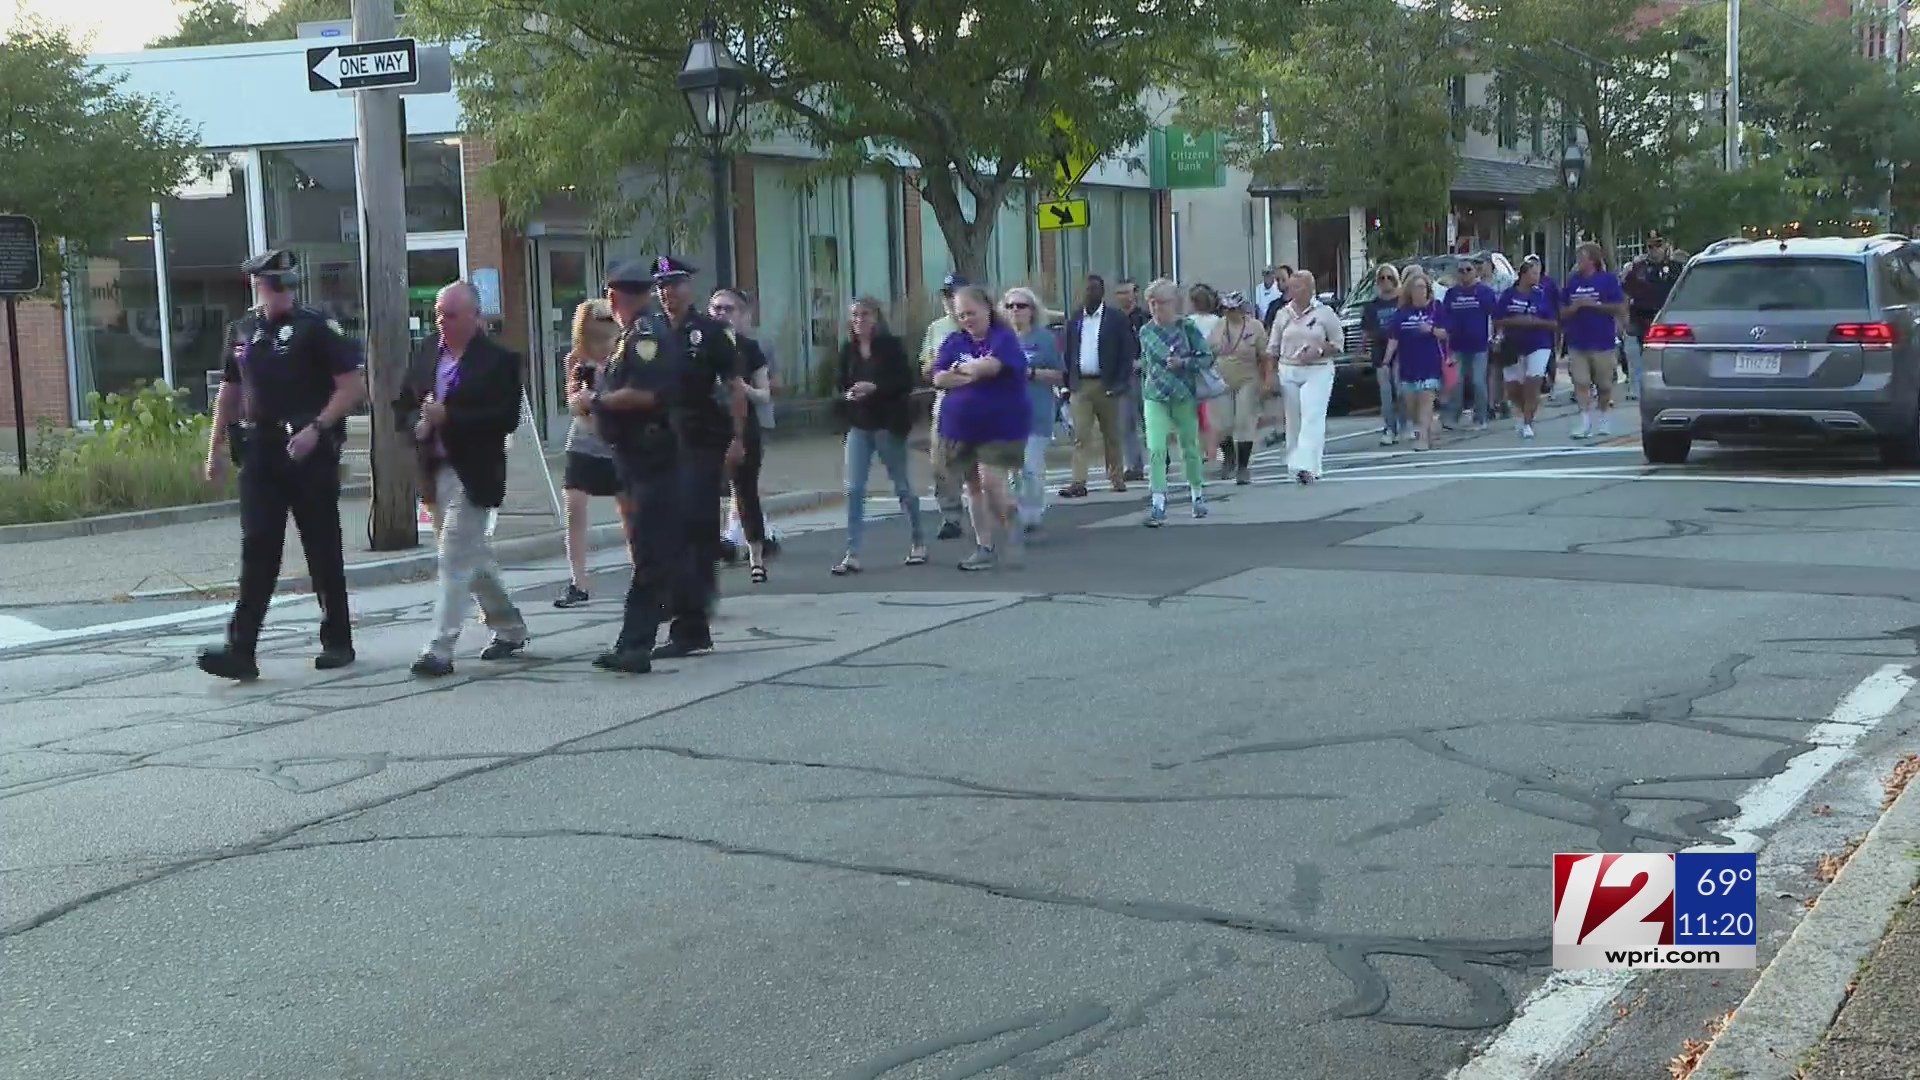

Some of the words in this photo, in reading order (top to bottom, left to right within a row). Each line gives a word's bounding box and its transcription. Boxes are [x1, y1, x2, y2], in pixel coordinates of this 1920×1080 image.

[340, 57, 369, 76] ONE
[374, 53, 404, 72] WAY
[1171, 151, 1210, 160] Citizens
[1177, 160, 1202, 171] Bank
